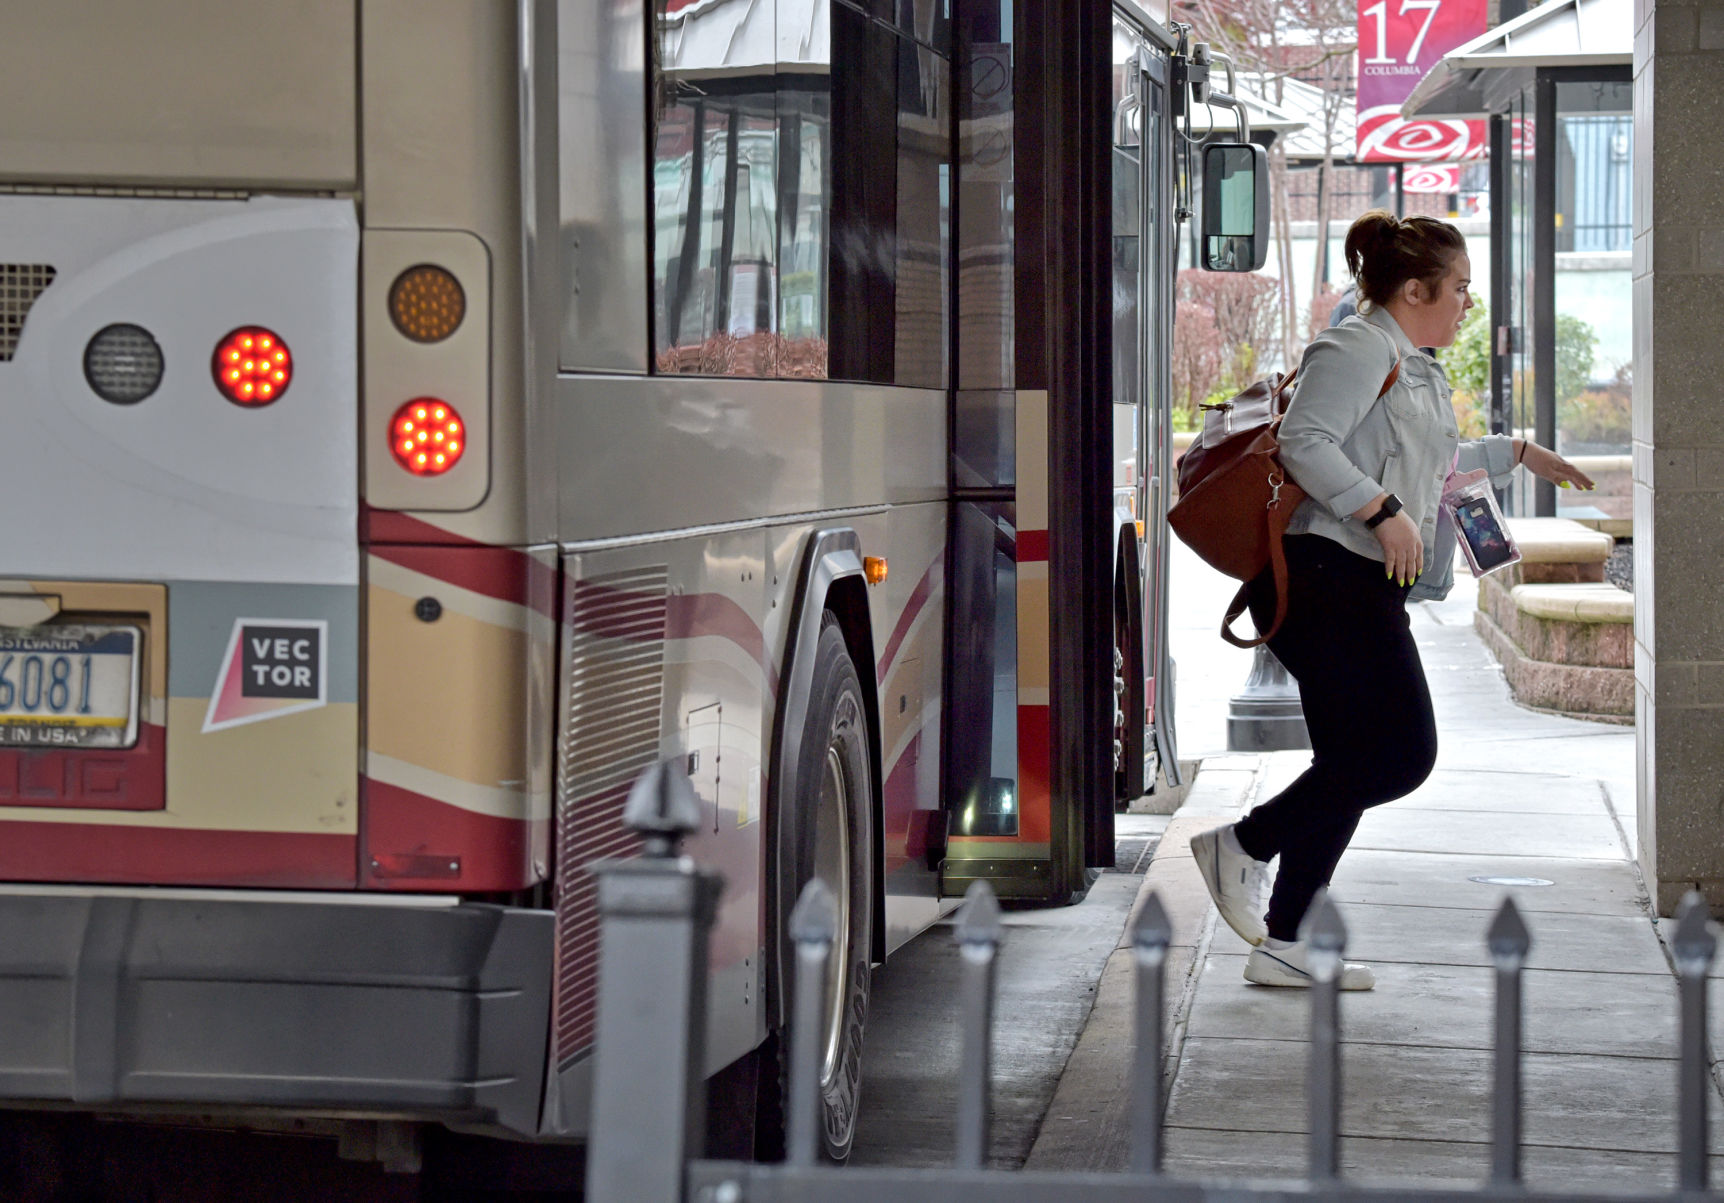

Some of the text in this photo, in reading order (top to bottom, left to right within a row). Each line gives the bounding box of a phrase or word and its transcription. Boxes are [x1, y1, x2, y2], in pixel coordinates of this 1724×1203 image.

[1363, 0, 1441, 64] 17
[1364, 66, 1421, 76] COLUMBIA
[0, 639, 79, 650] SYLVANIA
[251, 638, 310, 660] VEC
[0, 655, 91, 713] 6081
[251, 664, 311, 687] TOR
[11, 727, 31, 741] IN
[38, 727, 79, 743] USA
